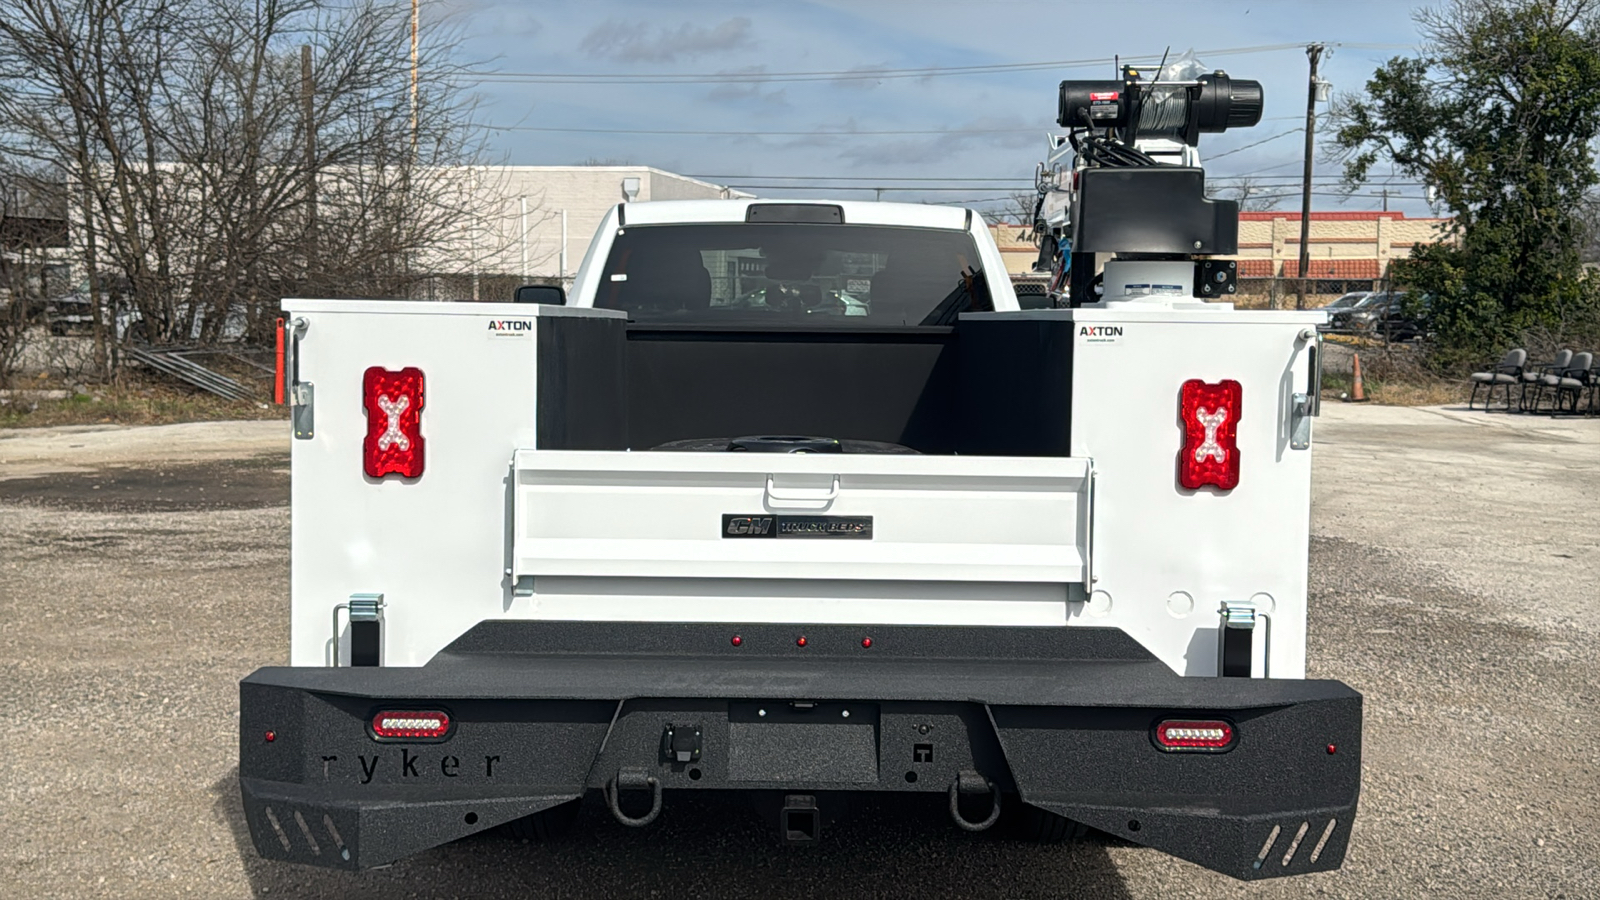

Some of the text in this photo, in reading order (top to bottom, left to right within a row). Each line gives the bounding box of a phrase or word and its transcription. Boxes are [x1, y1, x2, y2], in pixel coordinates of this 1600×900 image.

[488, 320, 532, 331] AXTON
[1079, 326, 1123, 336] AXTON
[726, 517, 865, 535] CM TRUCK BEDS
[321, 748, 501, 785] ryker
